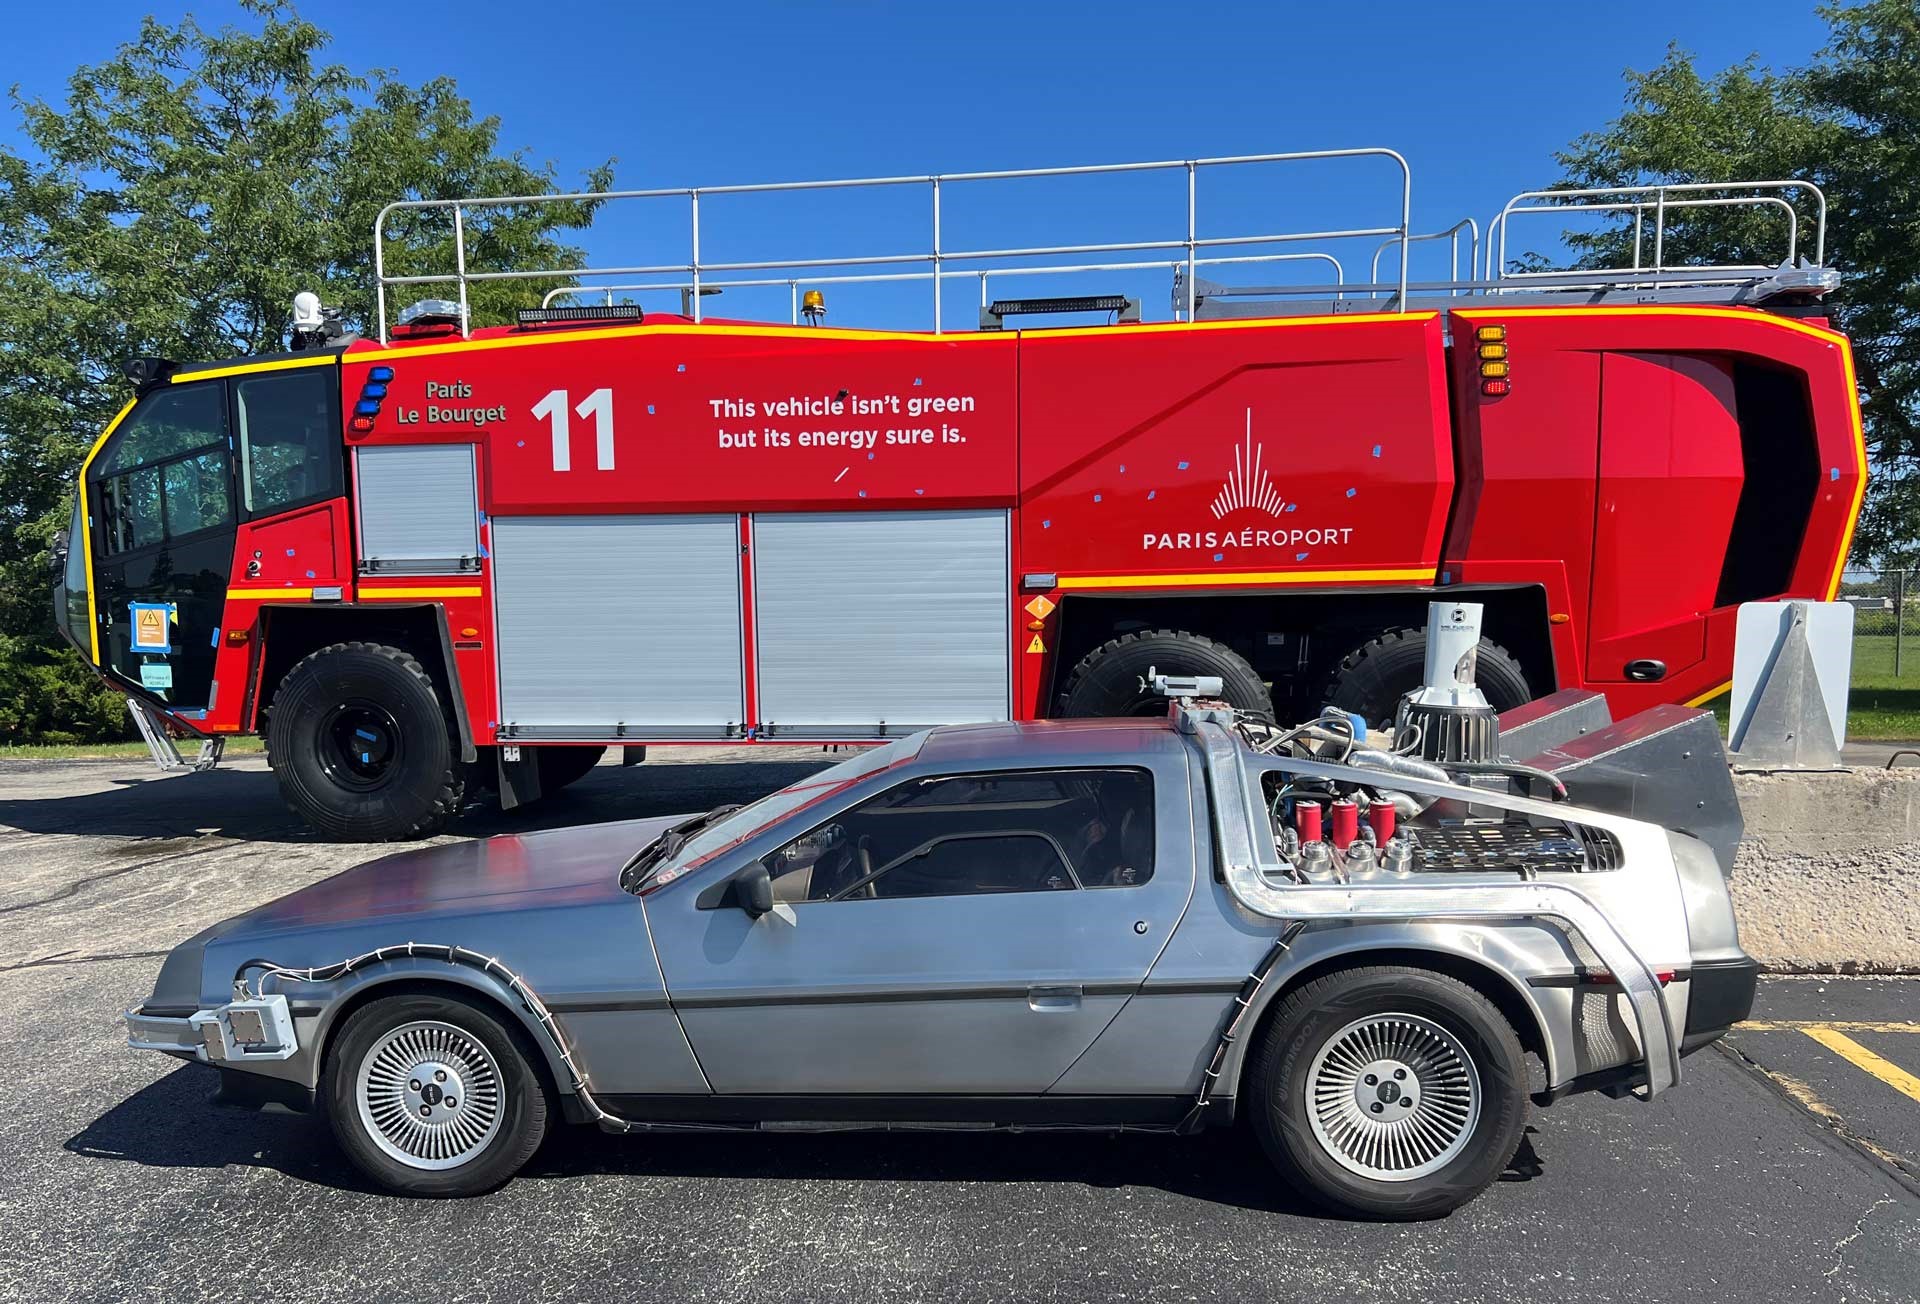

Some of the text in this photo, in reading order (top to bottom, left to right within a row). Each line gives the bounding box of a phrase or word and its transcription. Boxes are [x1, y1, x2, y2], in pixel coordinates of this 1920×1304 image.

[427, 379, 472, 398] Paris
[398, 405, 506, 426] Le Bourget
[709, 395, 975, 418] This vehicle isn't green
[530, 388, 616, 472] 11
[718, 424, 967, 449] but its energy sure is.
